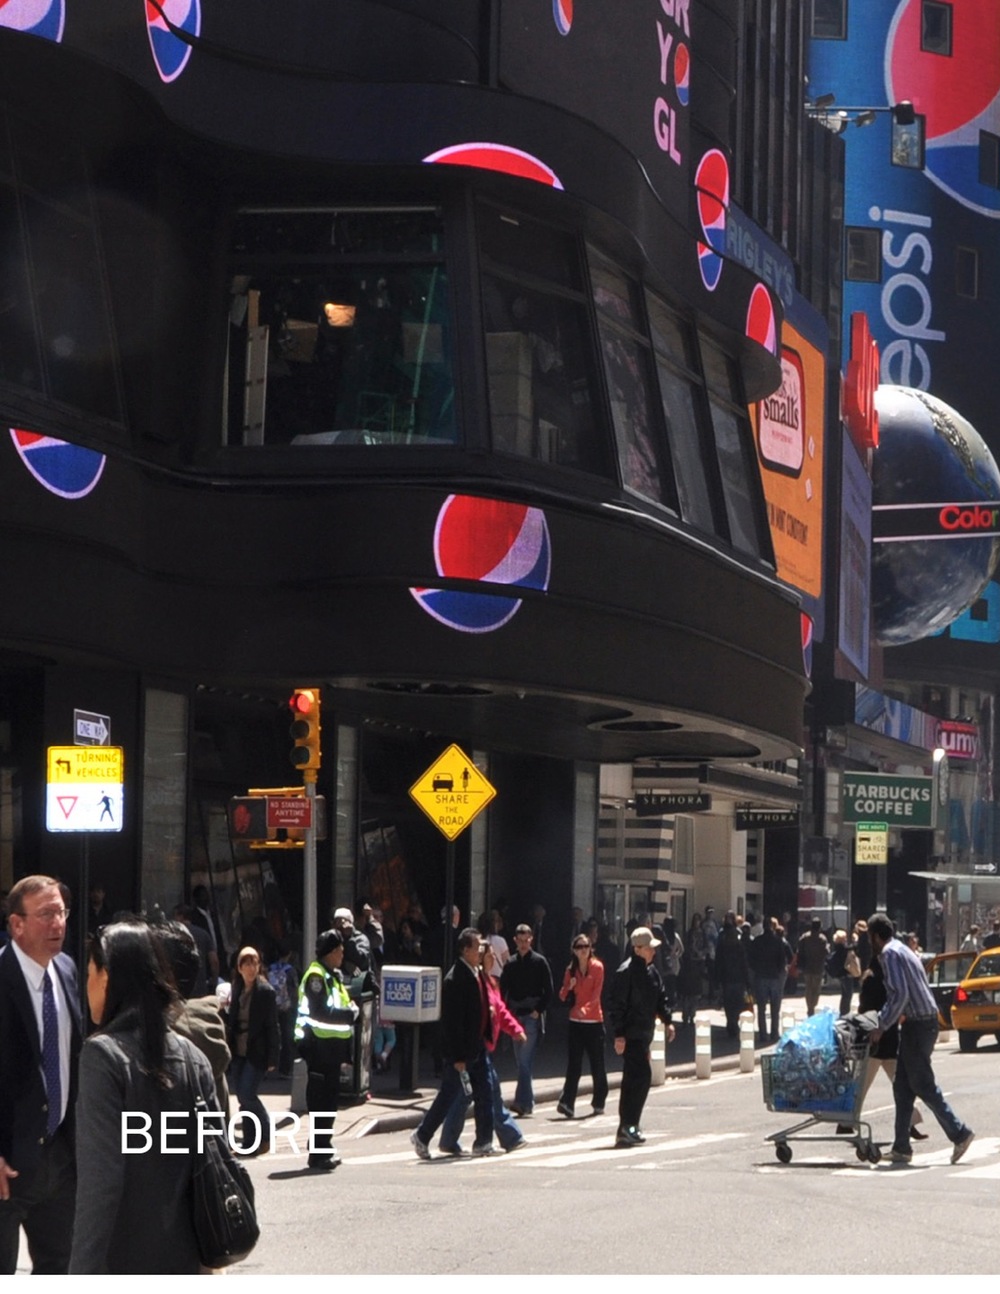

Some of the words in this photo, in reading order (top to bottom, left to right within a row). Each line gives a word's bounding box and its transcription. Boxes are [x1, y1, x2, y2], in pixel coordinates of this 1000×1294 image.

[725, 217, 795, 307] RIGLEY'S
[868, 205, 946, 392] epsi
[939, 505, 998, 531] Color
[76, 752, 118, 763] TURNING
[434, 794, 470, 804] SHARE
[643, 794, 704, 806] SEPHORA
[445, 806, 458, 814] THE
[854, 799, 914, 816] COFFEE
[275, 809, 305, 818] ANYTIME
[742, 812, 795, 823] SEPHORA
[438, 815, 465, 826] ROAD
[394, 982, 412, 992] USA
